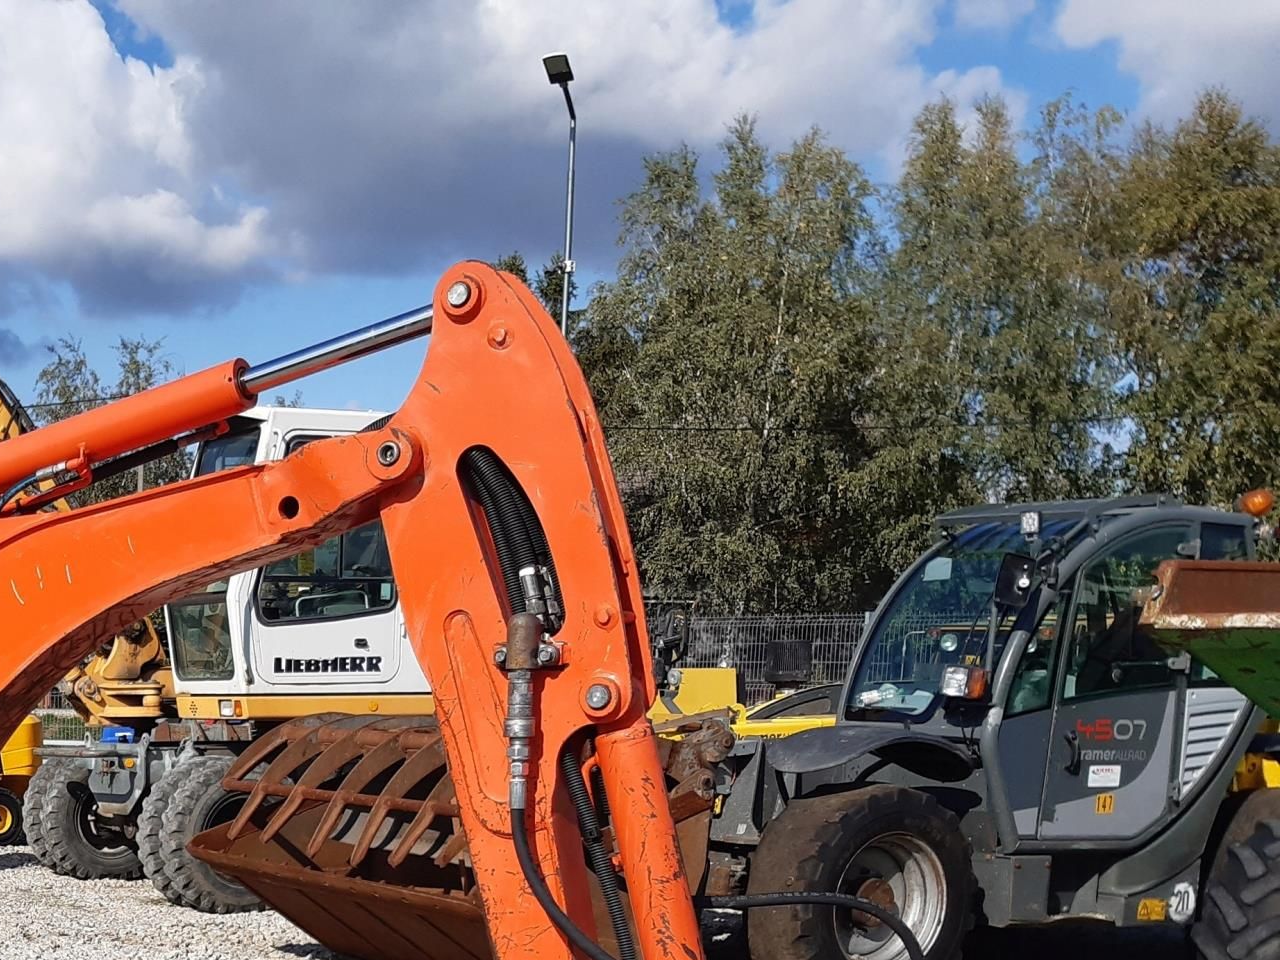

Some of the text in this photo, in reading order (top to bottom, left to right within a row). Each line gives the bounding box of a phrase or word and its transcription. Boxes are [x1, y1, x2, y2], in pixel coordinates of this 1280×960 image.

[273, 656, 382, 673] LIEBHERR
[1077, 719, 1147, 741] 4507
[1175, 889, 1191, 913] 20
